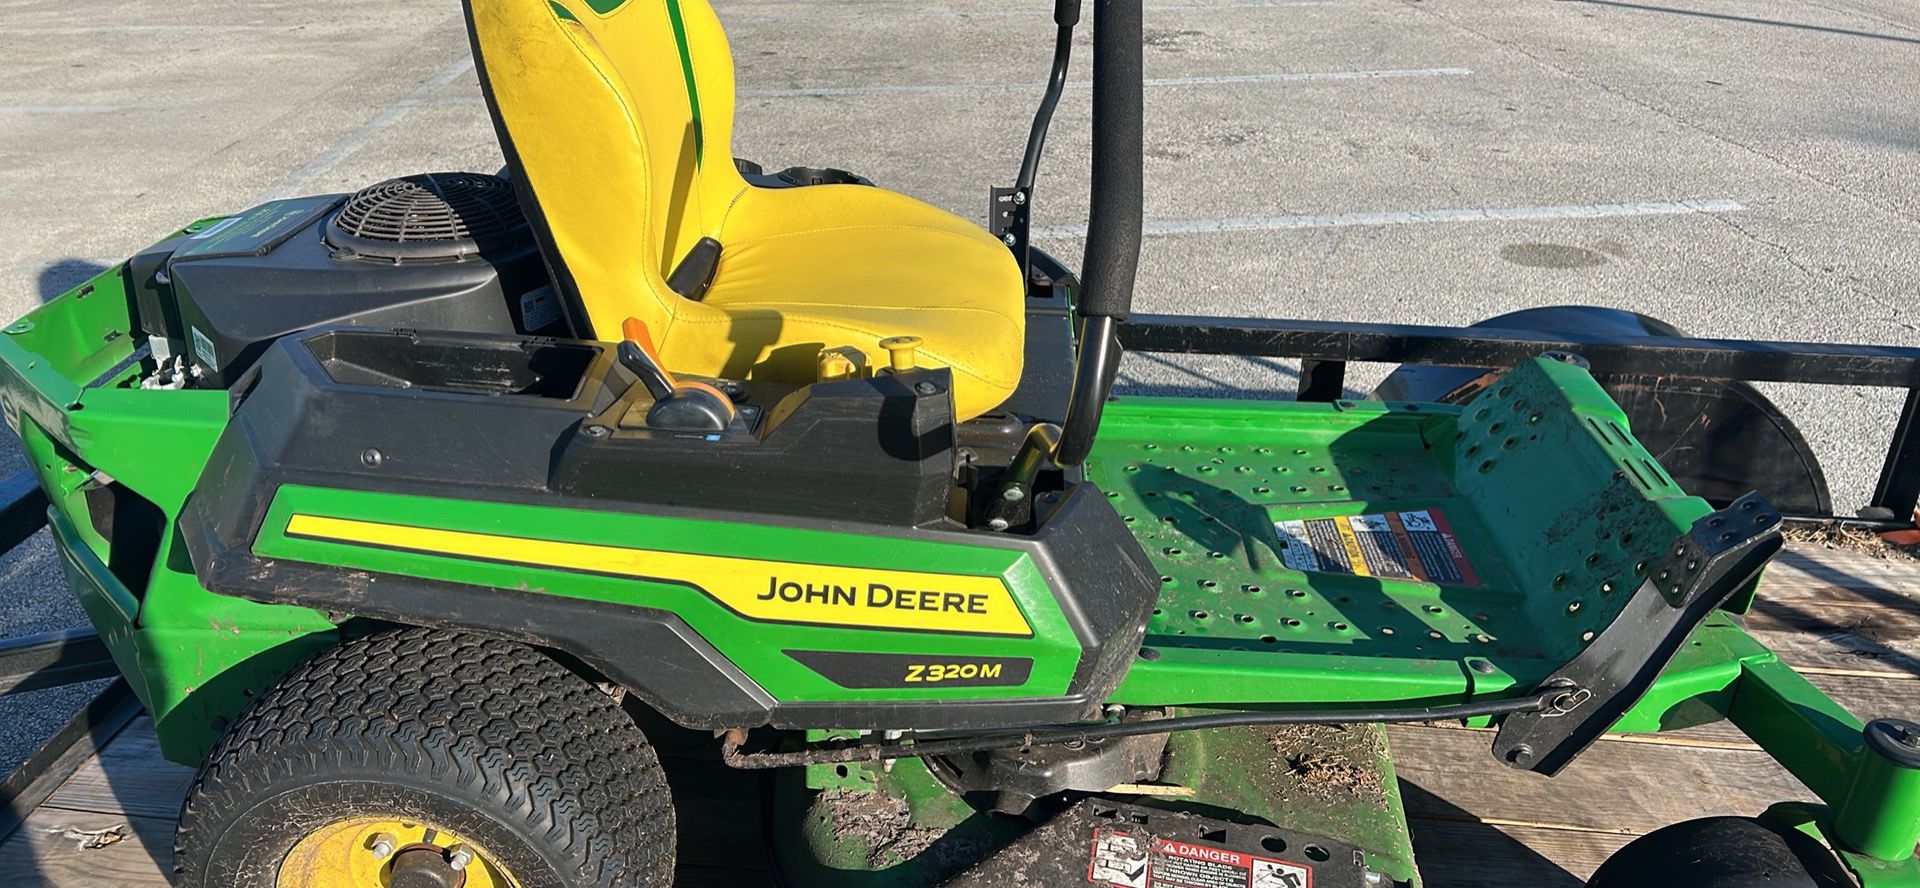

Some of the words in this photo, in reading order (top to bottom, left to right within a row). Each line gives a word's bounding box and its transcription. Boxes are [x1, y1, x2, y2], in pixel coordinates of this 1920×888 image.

[757, 576, 856, 607] JOHN
[867, 584, 989, 614] DEERE
[1168, 855, 1206, 866] ROTATING
[1207, 861, 1233, 871] BLADE
[1179, 845, 1240, 865] DANGER
[1166, 868, 1198, 877] THROWN
[1199, 873, 1235, 883] OBJECTS
